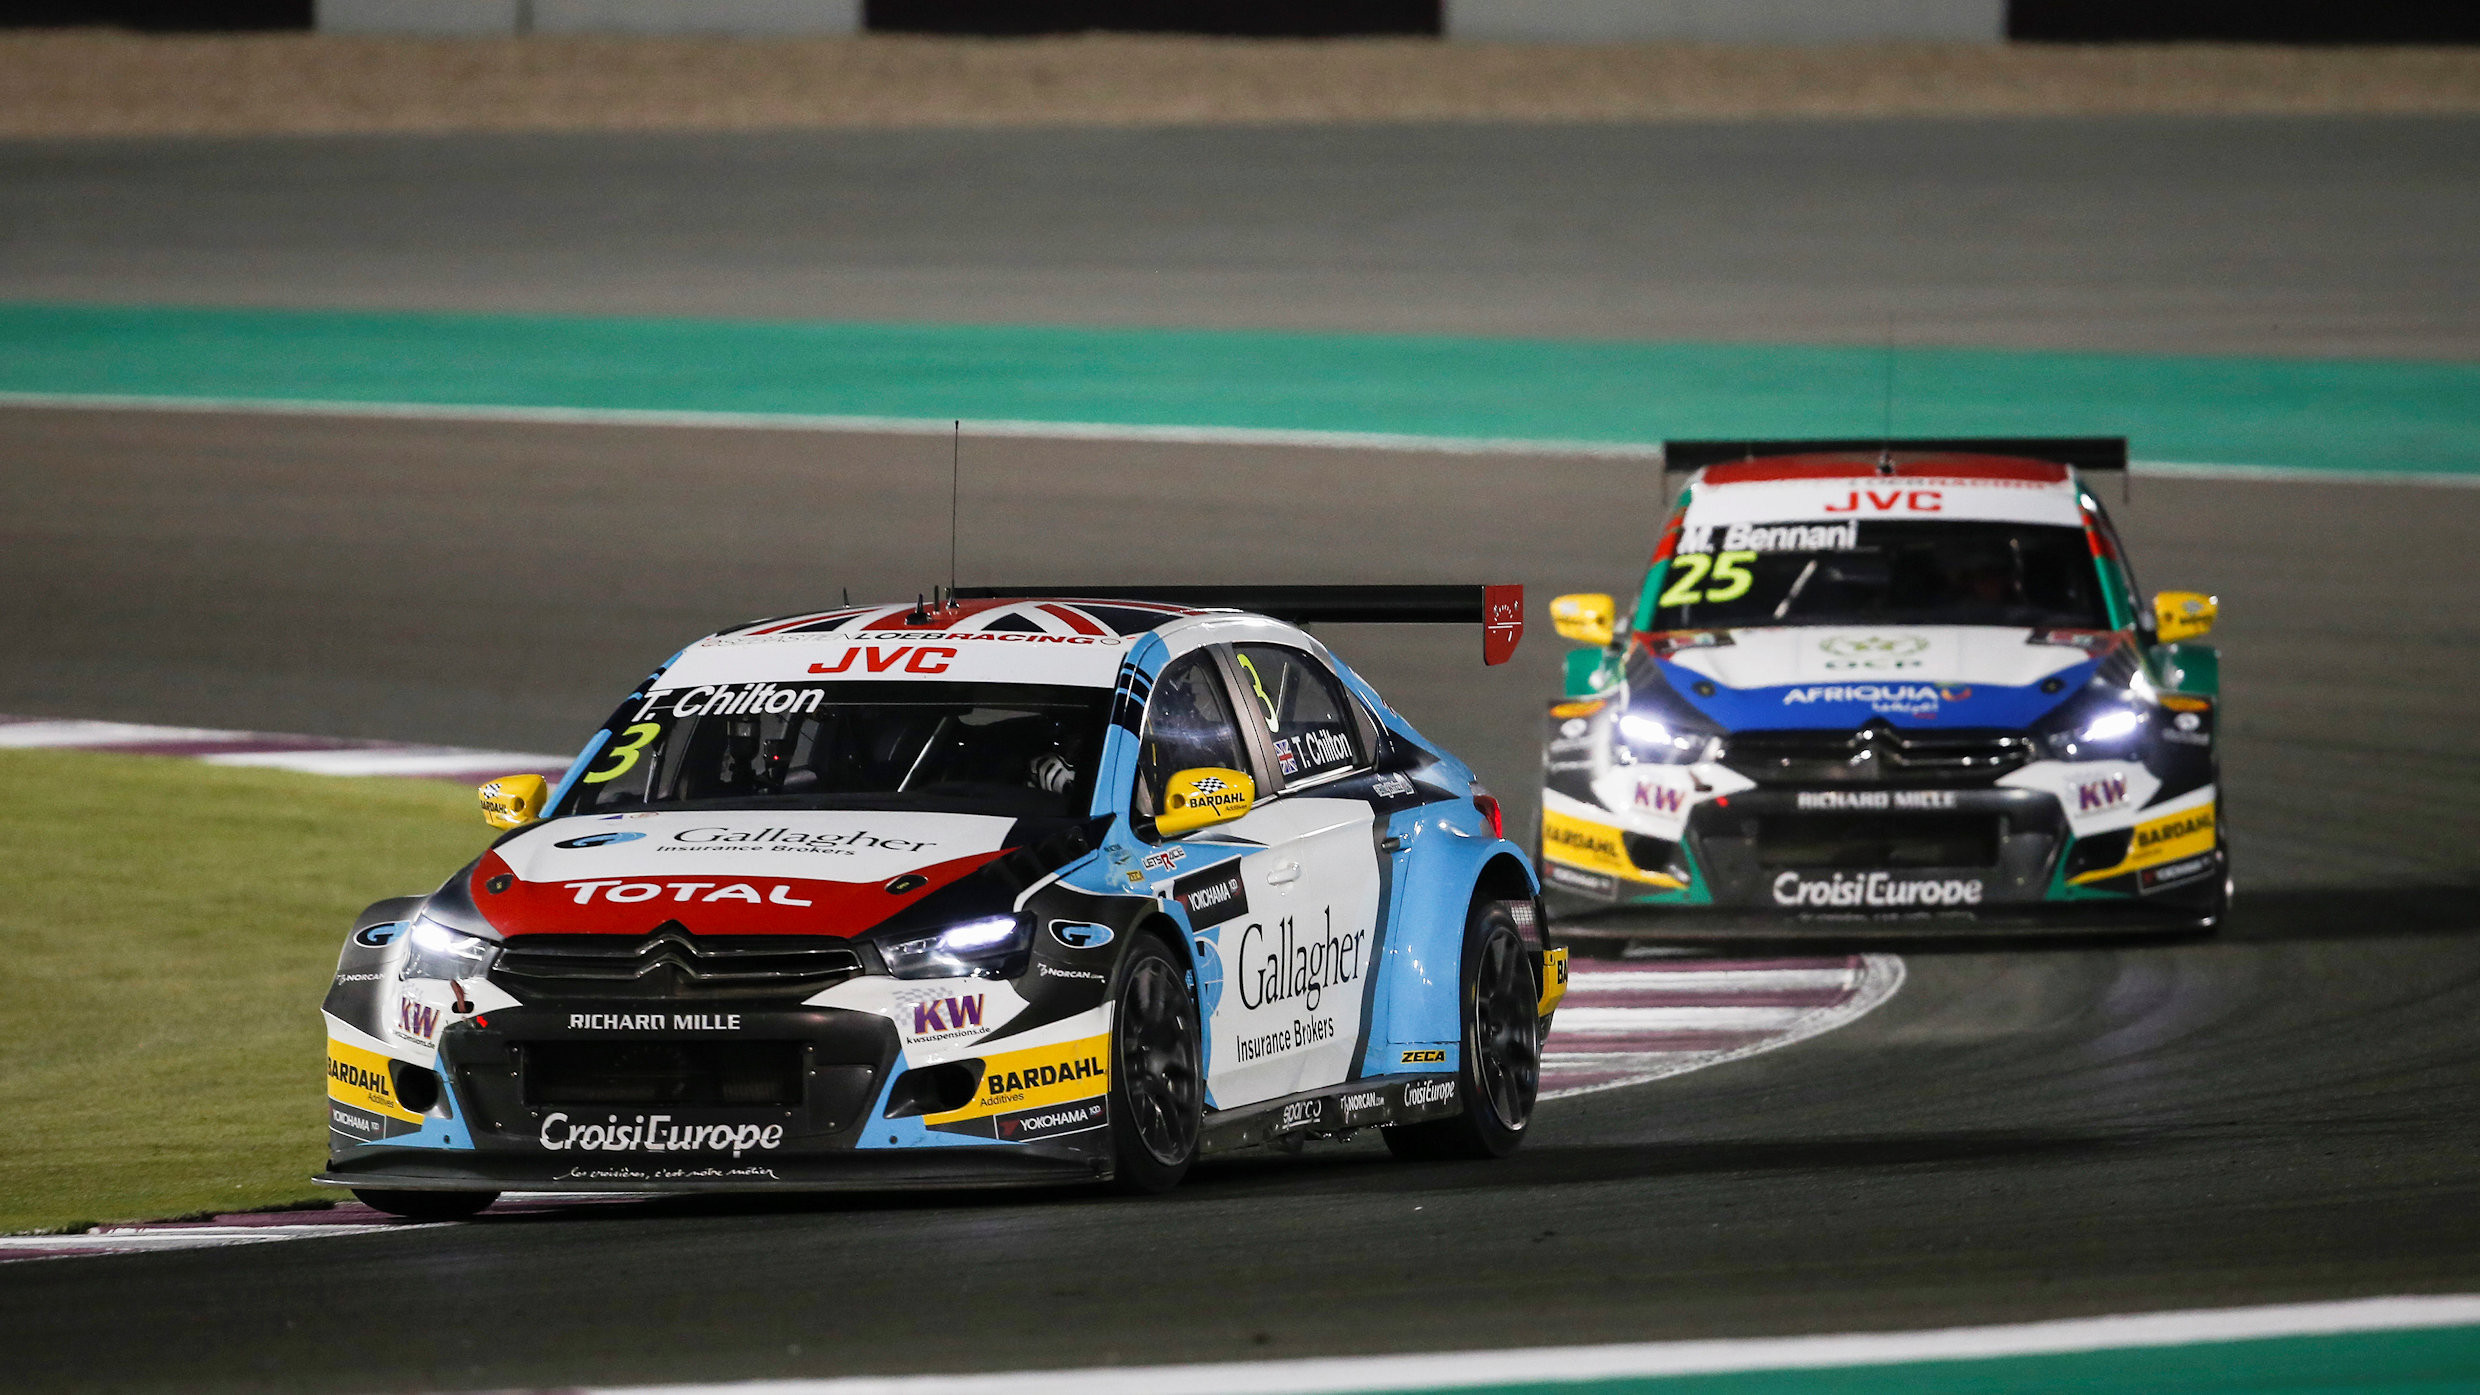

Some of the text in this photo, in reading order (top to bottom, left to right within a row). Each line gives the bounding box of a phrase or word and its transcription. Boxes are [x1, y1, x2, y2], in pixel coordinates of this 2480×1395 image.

[1825, 491, 1942, 512] JVC
[1723, 520, 1859, 551] Bennani
[1659, 550, 1758, 607] 25
[808, 646, 957, 674] JVC
[631, 682, 826, 722] T. Chilton
[1236, 653, 1280, 733] 3
[1782, 686, 1939, 705] AFRIQUIA
[583, 722, 661, 783] 3
[1291, 729, 1353, 768] T. Chilton
[1190, 792, 1246, 808] BARDAHL
[1797, 790, 1957, 810] RICHARD MILLE
[2080, 774, 2128, 810] KW
[656, 844, 856, 857] Insurance Brokers
[674, 827, 938, 853] Gallagher
[564, 879, 812, 908] TOTAL
[1188, 883, 1231, 911] YOKOHAMA
[1773, 871, 1983, 906] CroisiEurope
[1239, 905, 1365, 1010] Gallagher
[399, 996, 440, 1039] KW
[567, 1013, 741, 1030] RICHARD MILLE
[914, 993, 984, 1035] KW
[906, 1026, 991, 1045] kwsuspensions.de
[1237, 1015, 1334, 1062] Insurance Brokers
[1402, 1050, 1445, 1063] ZECA
[988, 1057, 1104, 1095] BARDAHL
[980, 1092, 1025, 1107] Additives
[1404, 1079, 1456, 1107] CroisiEurope
[332, 1110, 370, 1132] YOKOHAMA
[1020, 1108, 1089, 1131] YOKOHAMA
[1283, 1099, 1322, 1126] sparco
[539, 1112, 783, 1158] CroisiEurope
